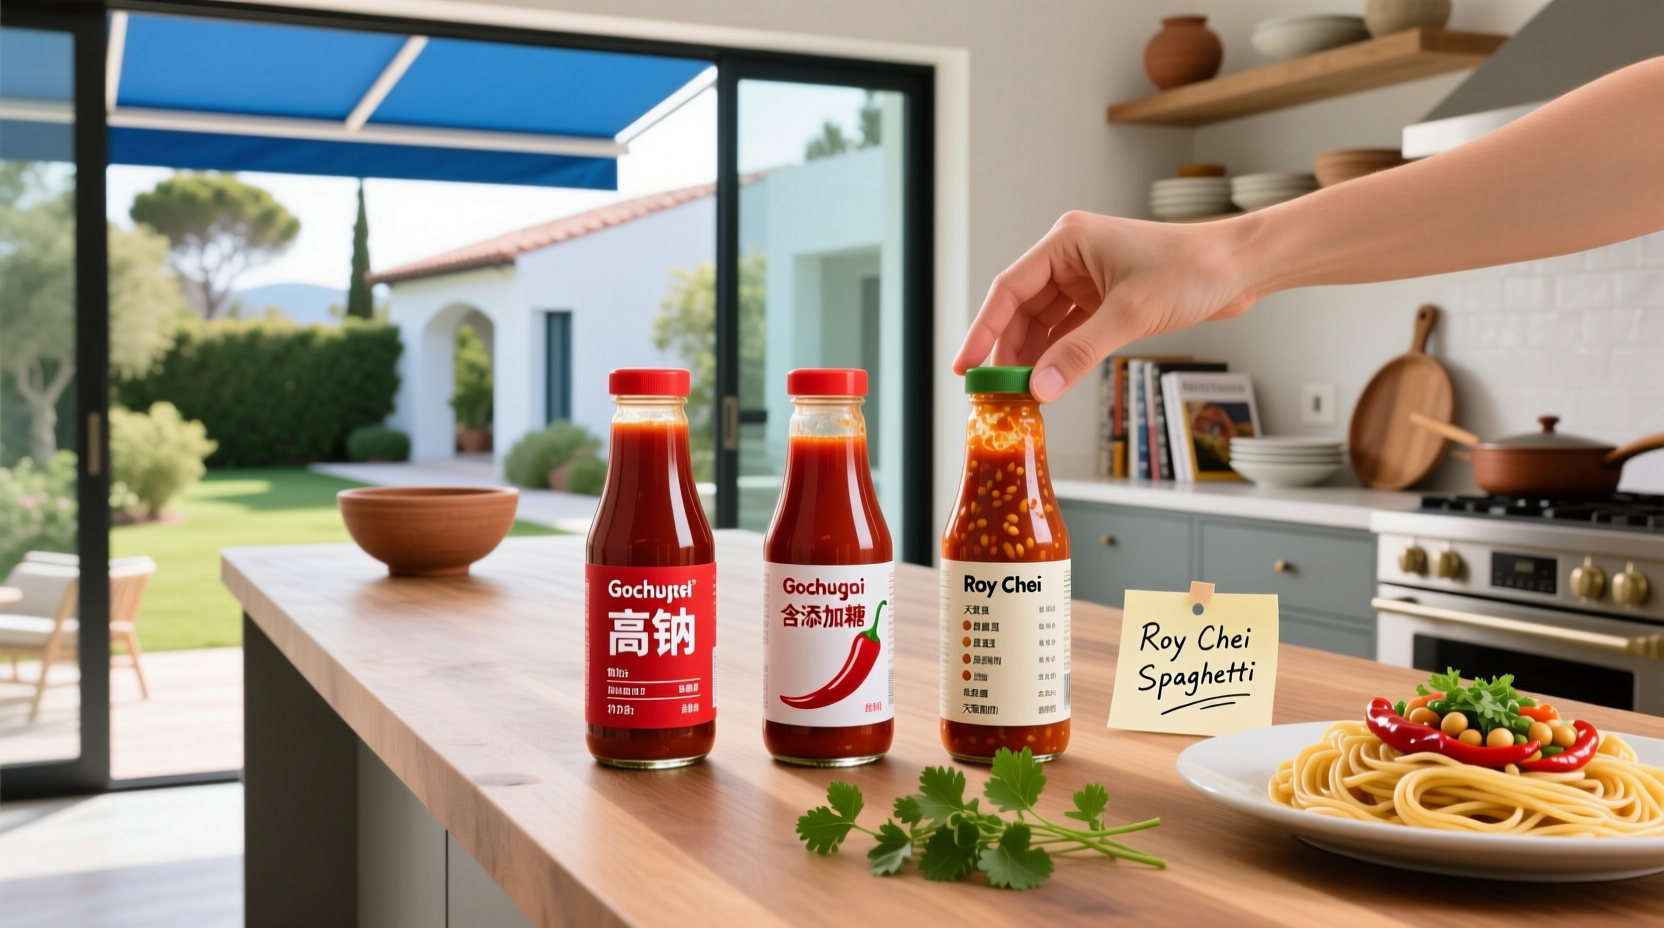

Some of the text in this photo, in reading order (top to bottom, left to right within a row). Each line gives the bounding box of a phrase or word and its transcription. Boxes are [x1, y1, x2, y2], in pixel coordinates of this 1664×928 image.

[964, 575, 1042, 598] Roy Chei
[608, 607, 696, 657] 高钠
[780, 603, 866, 628] 含添加糖
[1140, 621, 1252, 662] Roy Chei
[1137, 661, 1256, 700] Spaghetti
